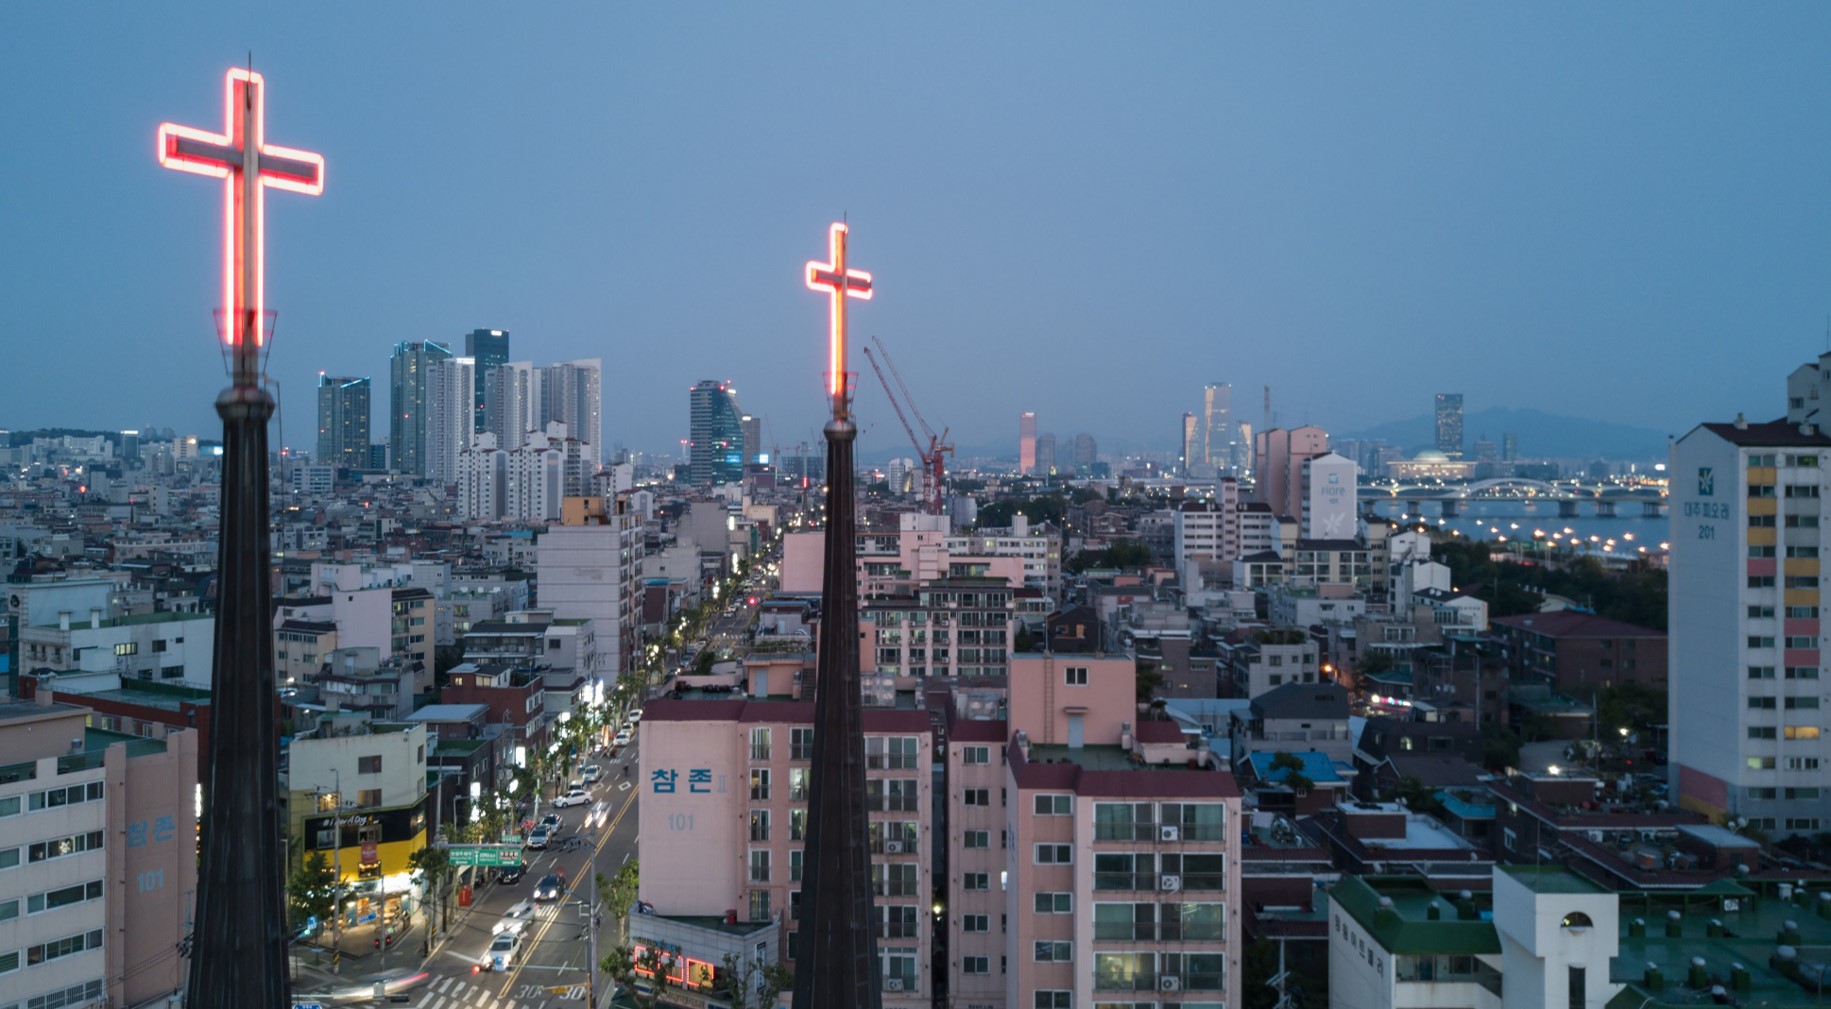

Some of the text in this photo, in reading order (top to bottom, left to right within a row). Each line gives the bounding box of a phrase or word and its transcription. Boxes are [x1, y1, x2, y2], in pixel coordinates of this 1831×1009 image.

[1698, 525, 1715, 540] 201
[668, 812, 695, 832] 101
[137, 868, 165, 895] 101
[514, 984, 541, 999] 30
